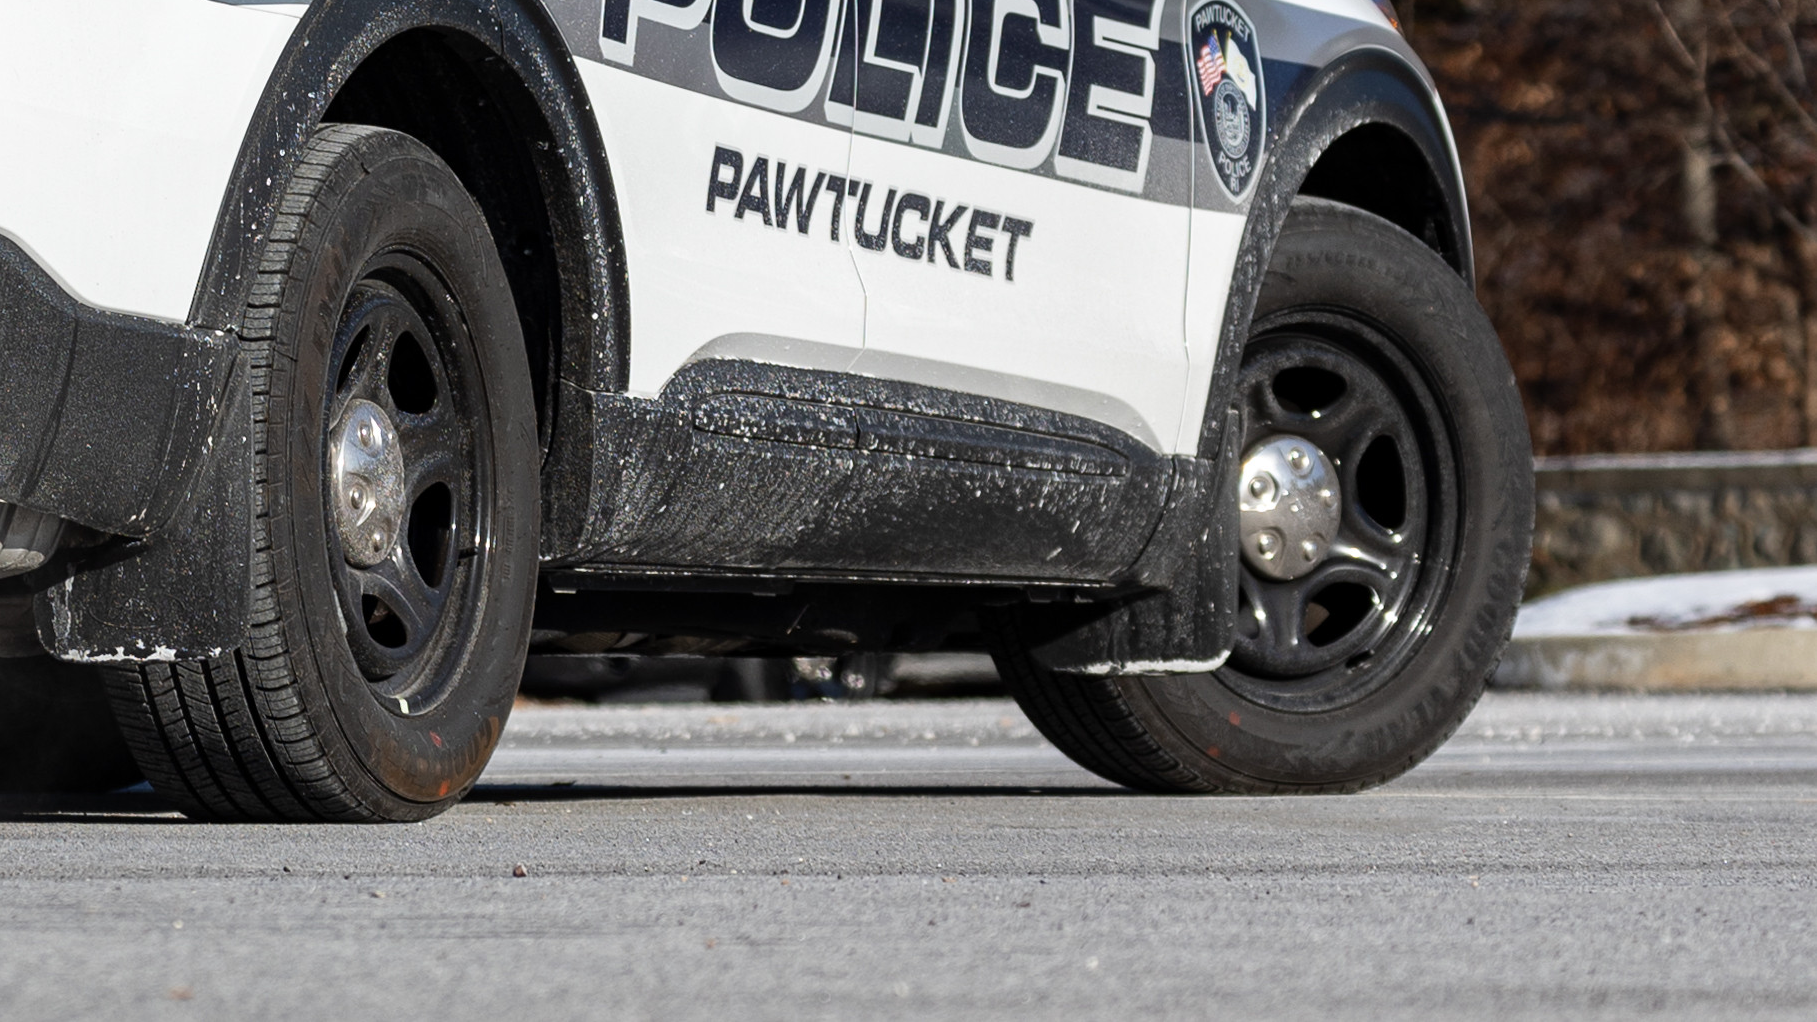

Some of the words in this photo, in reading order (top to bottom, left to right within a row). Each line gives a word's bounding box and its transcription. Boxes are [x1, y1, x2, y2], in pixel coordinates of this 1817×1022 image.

[1196, 4, 1251, 43] PAWTUCKET
[1218, 153, 1252, 179] POLICE
[1229, 178, 1240, 192] RI
[706, 142, 1035, 281] PAWTUCKET
